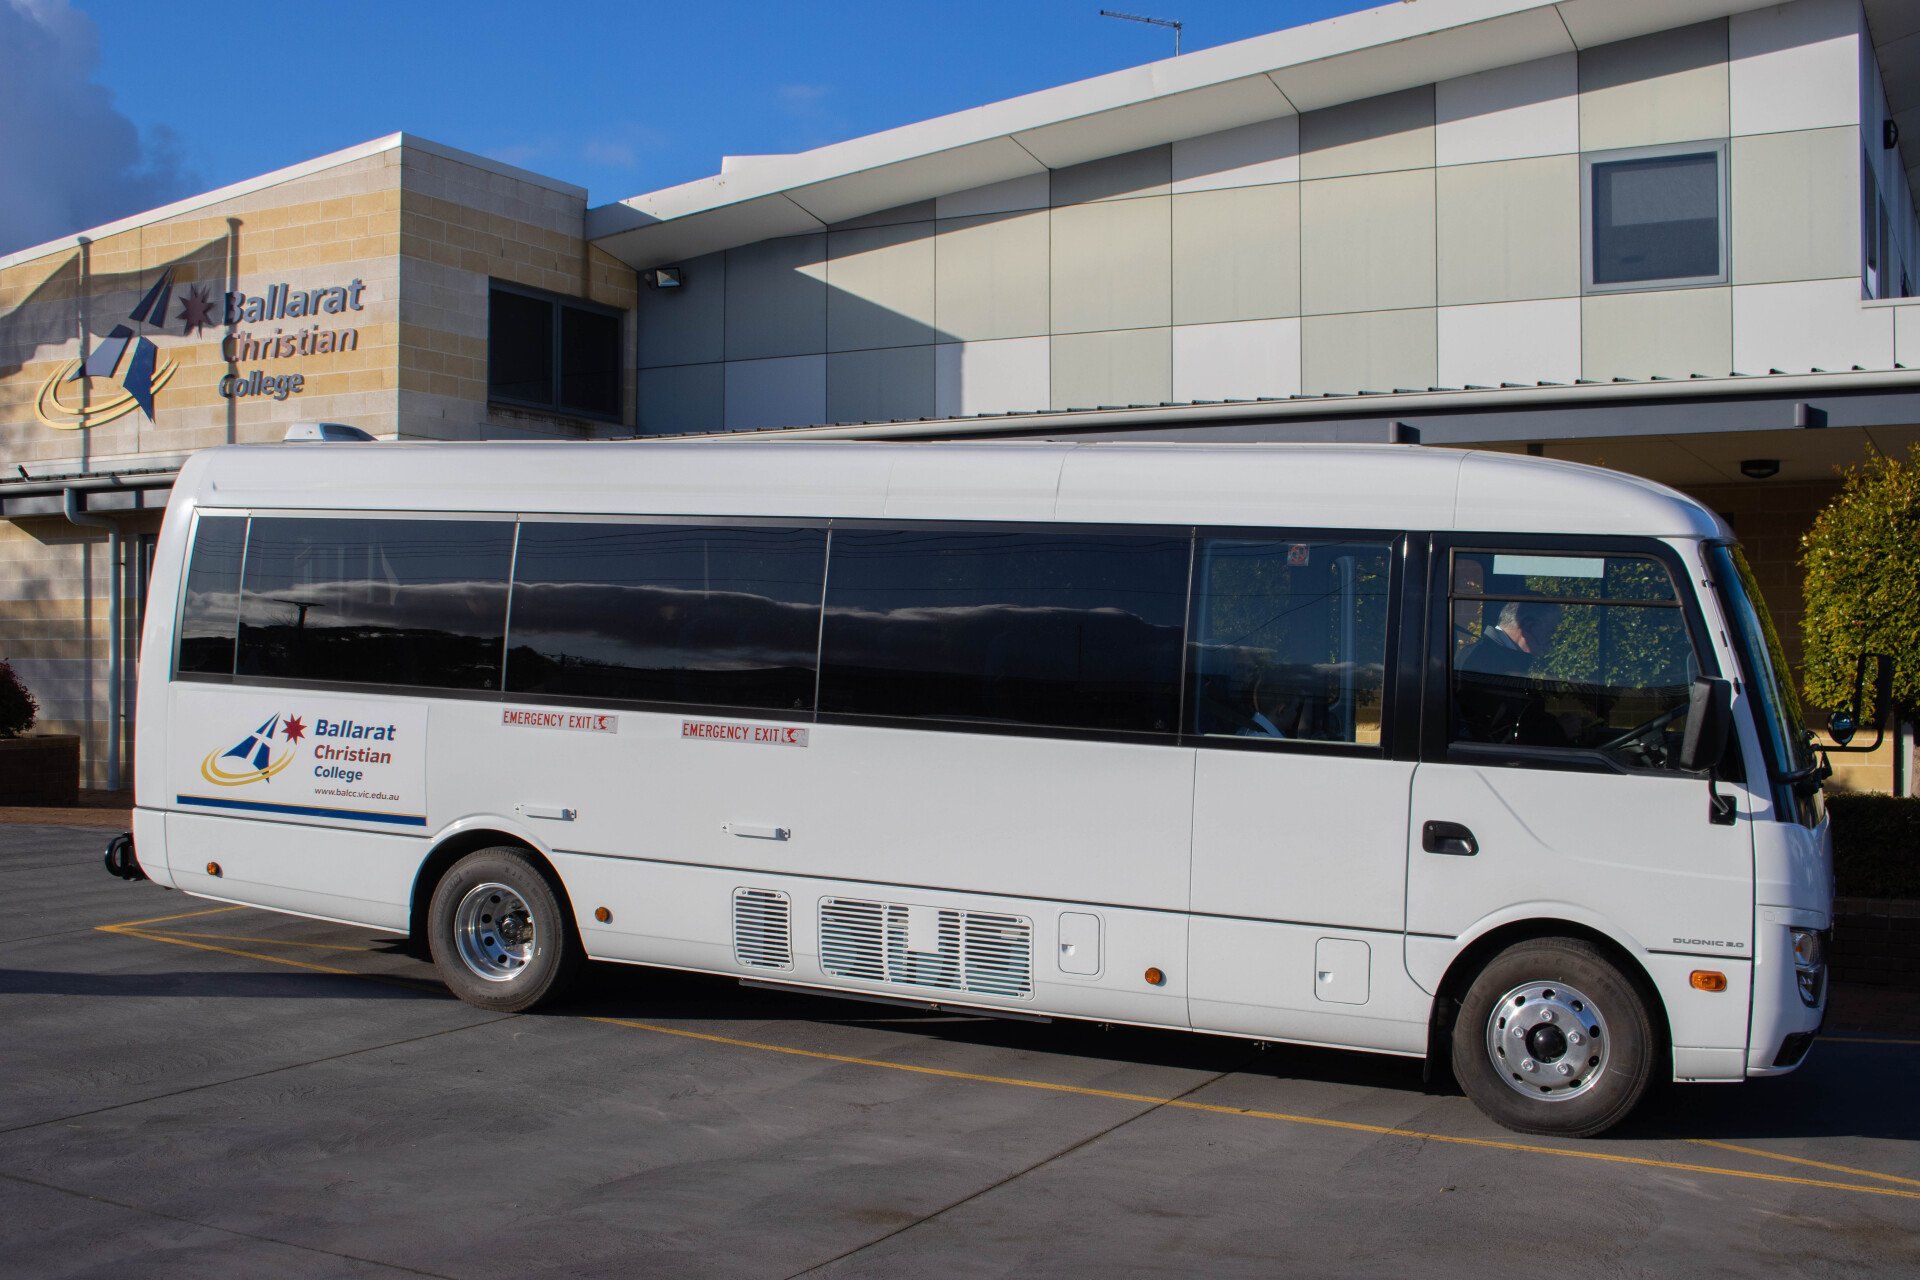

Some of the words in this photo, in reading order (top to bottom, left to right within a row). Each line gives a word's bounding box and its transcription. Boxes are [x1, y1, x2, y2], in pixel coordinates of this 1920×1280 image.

[223, 278, 366, 326] Ballarat
[221, 324, 358, 363] Christian
[219, 369, 305, 400] College
[503, 710, 564, 727] EMERGENCY
[569, 715, 591, 729] EXIT
[315, 719, 396, 741] Ballarat
[682, 723, 749, 740] EMERGENCY
[754, 728, 780, 742] EXIT
[315, 745, 392, 764] Christian
[315, 766, 363, 783] College
[315, 787, 400, 801] www.balcc.vic.edu.au
[1672, 937, 1724, 947] DUONIC
